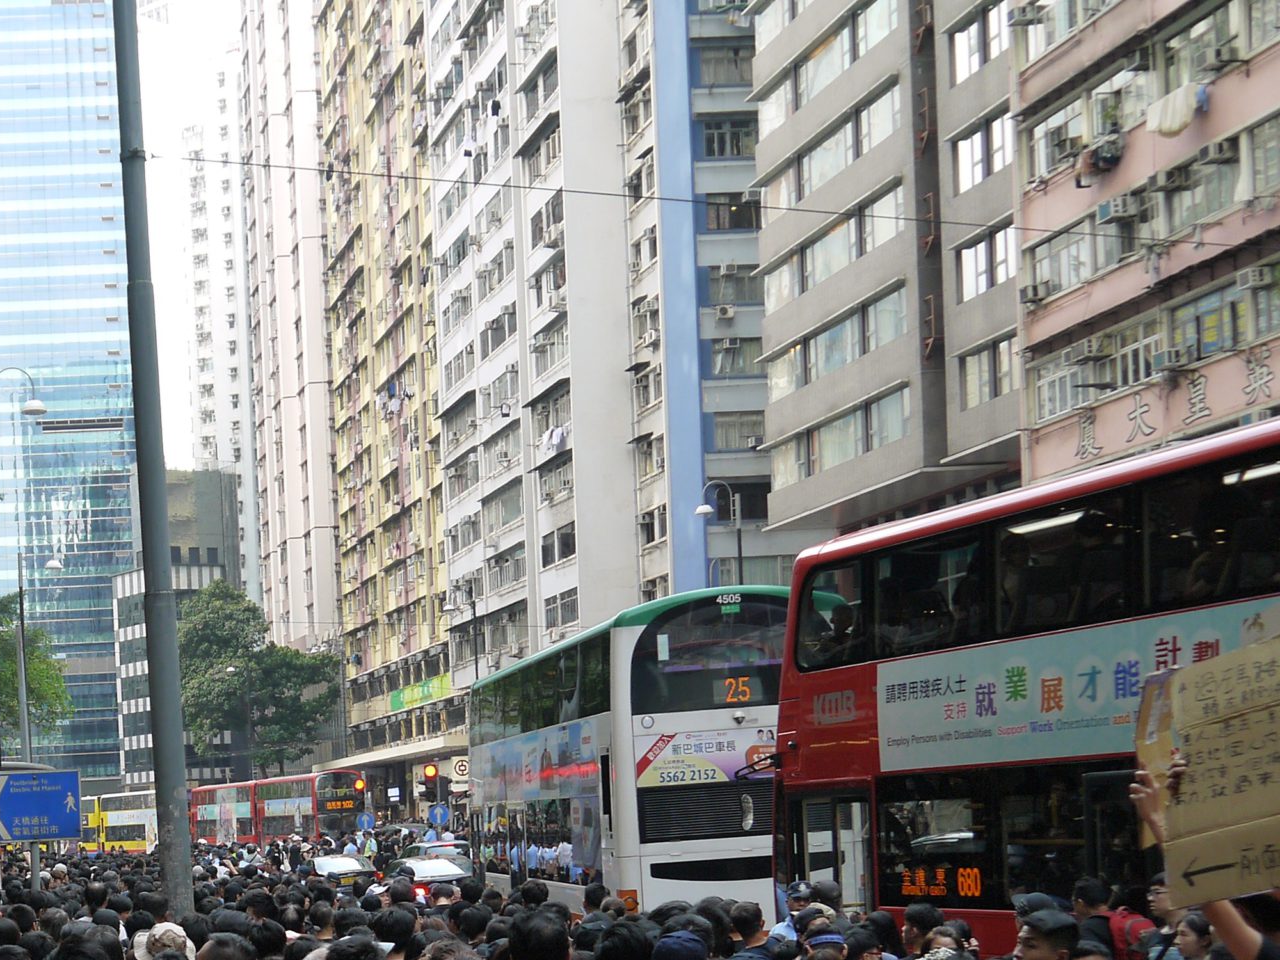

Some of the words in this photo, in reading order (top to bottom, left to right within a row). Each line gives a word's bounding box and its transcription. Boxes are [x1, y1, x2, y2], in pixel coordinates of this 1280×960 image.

[716, 594, 741, 604] 4505
[724, 676, 751, 703] 25
[885, 674, 967, 704] 請聘用殘疾人士
[943, 701, 967, 721] 支持
[887, 736, 910, 748] Employ
[911, 735, 938, 745] Persons
[938, 731, 953, 741] with
[953, 728, 993, 740] Disabilities
[996, 724, 1028, 737] Support
[1029, 720, 1054, 734] Work
[1055, 716, 1110, 732] Orientation
[1112, 712, 1131, 726] and
[671, 740, 737, 756] 新巴城巴車長
[659, 771, 686, 783] 5562
[690, 768, 717, 781] 2152
[957, 867, 982, 897] 680
